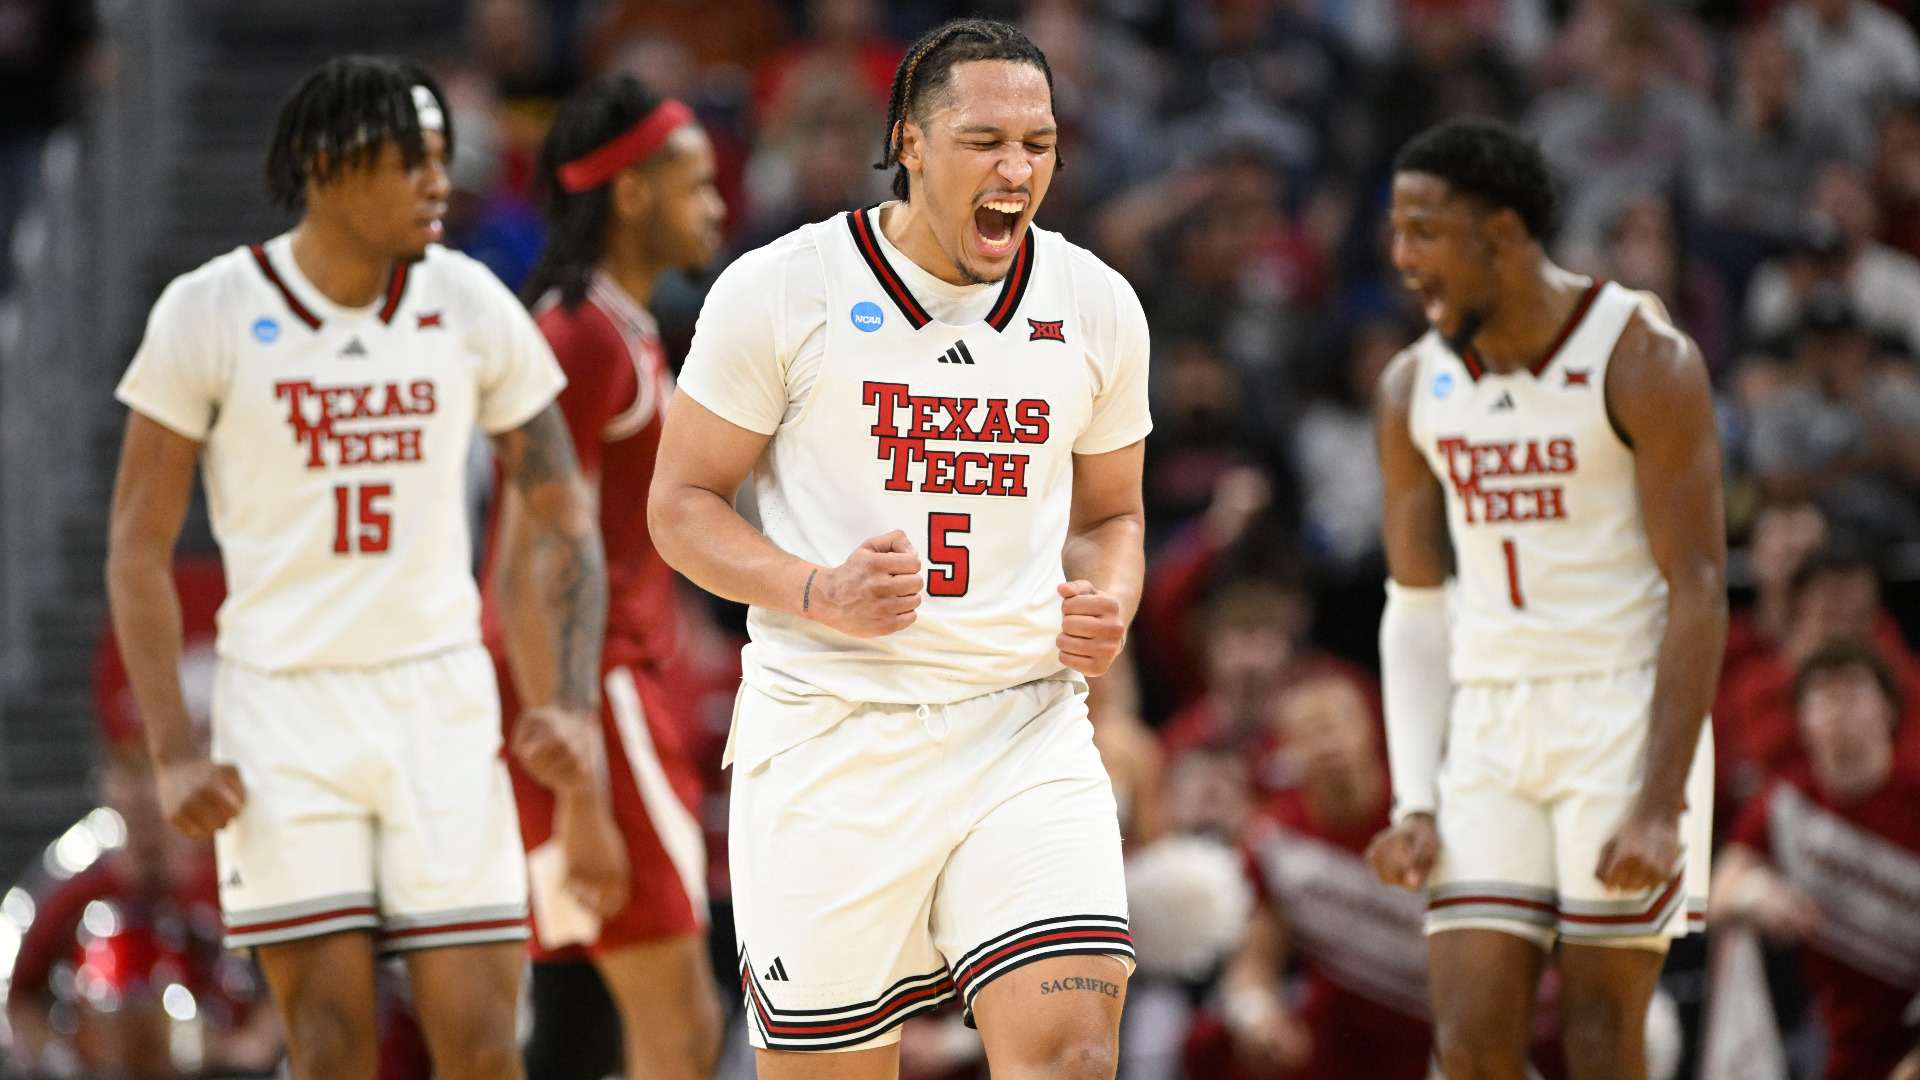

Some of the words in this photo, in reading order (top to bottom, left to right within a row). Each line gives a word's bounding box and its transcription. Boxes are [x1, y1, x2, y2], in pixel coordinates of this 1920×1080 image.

[855, 314, 881, 325] NCAA
[274, 380, 437, 426] TEXAS
[862, 381, 1050, 444] TEXAS
[295, 422, 423, 468] TECH
[877, 436, 1030, 497] TECH
[1436, 436, 1577, 478] TEXAS
[333, 484, 392, 554] 15
[1455, 480, 1567, 524] TECH
[926, 511, 972, 597] 5
[1502, 538, 1524, 608] 1
[1041, 977, 1119, 999] SACRIFICE
